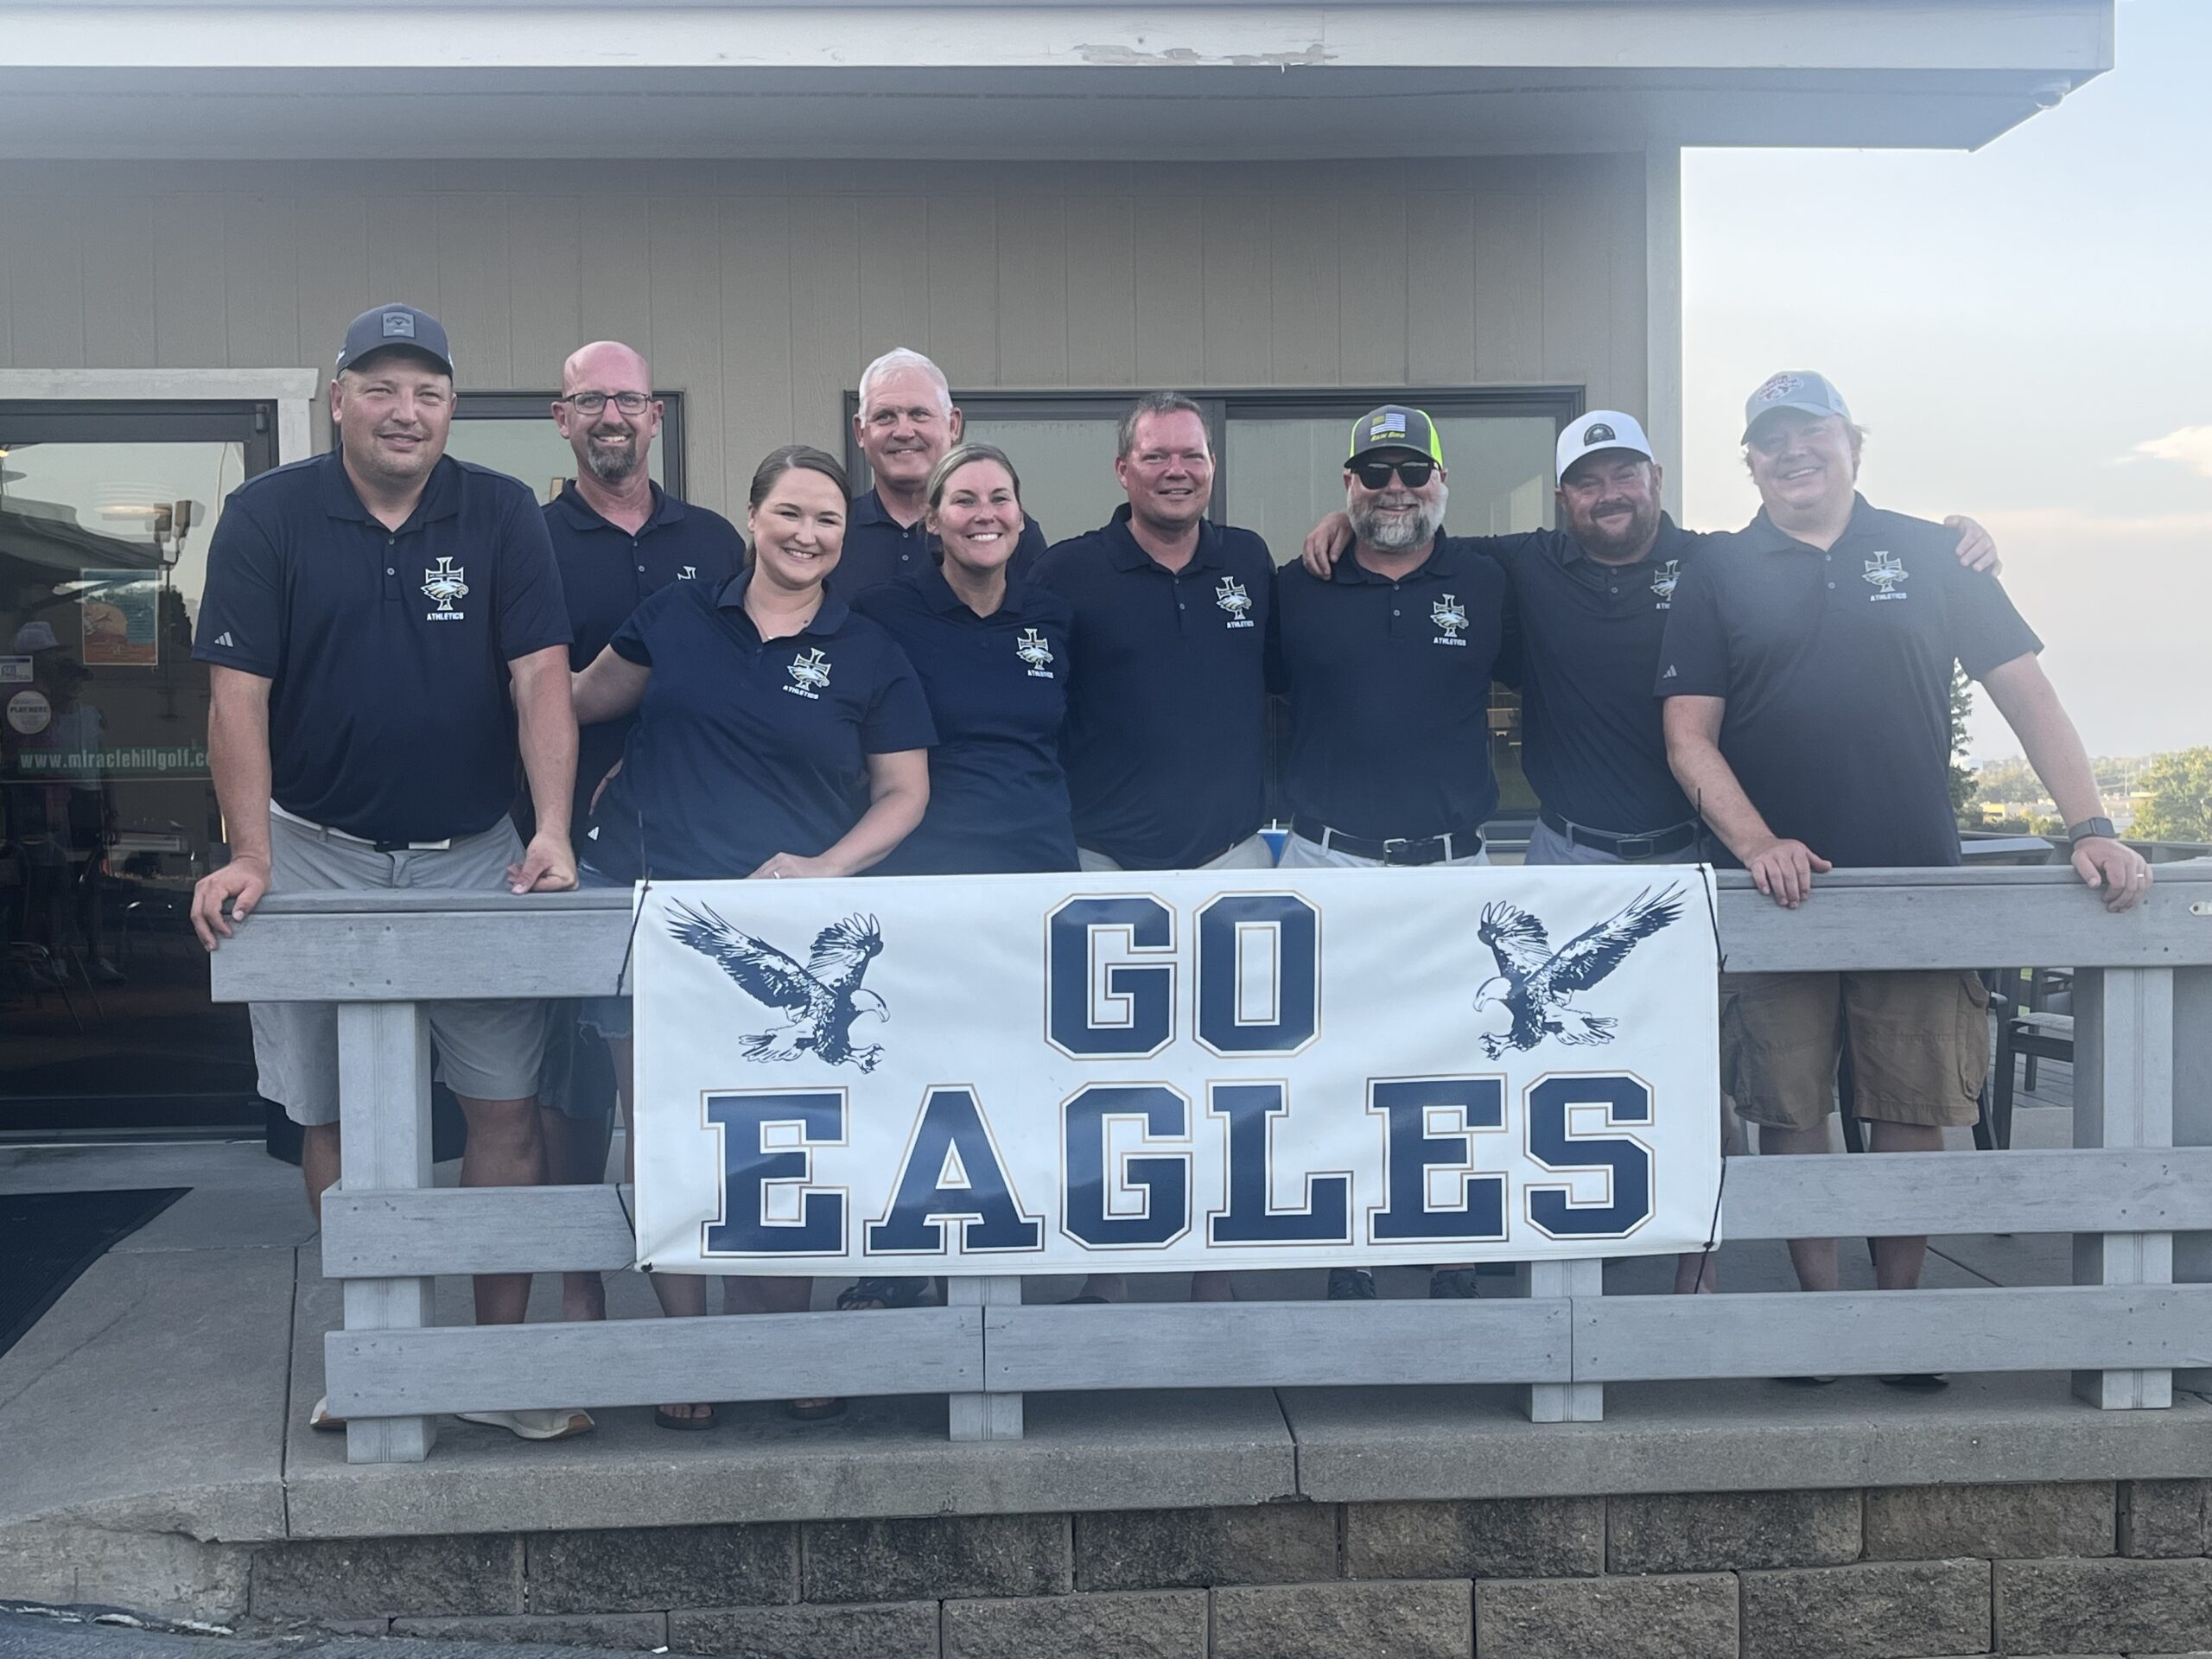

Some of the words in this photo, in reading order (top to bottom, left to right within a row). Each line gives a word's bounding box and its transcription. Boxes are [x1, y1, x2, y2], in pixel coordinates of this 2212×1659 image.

[1870, 593, 1907, 601] ATHLETICS
[427, 612, 464, 620] ATHLETICS
[1433, 637, 1466, 646] ATHLETICS
[782, 684, 819, 700] ATHLETICS
[1045, 890, 1322, 1060] GO
[701, 1071, 1655, 1258] EAGLES
